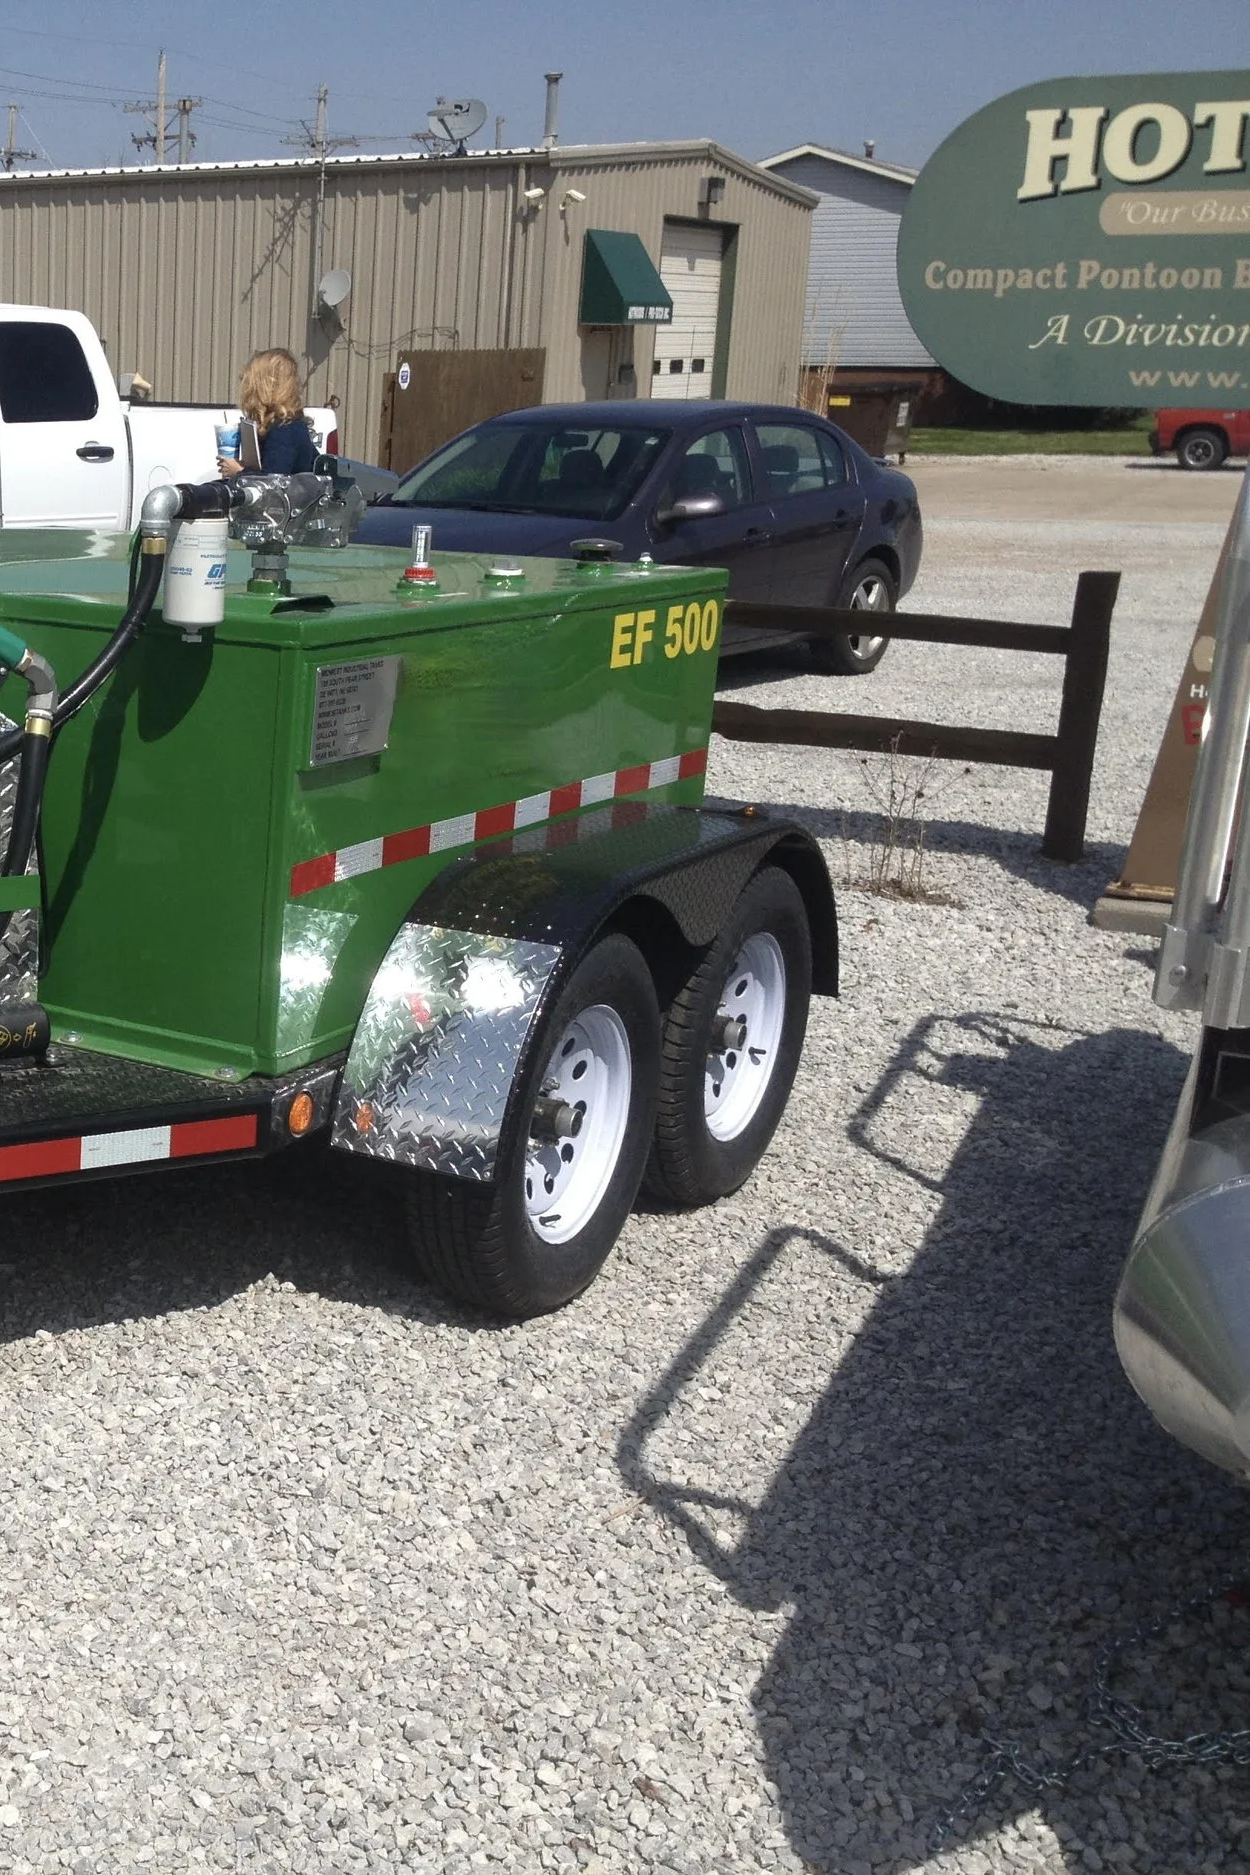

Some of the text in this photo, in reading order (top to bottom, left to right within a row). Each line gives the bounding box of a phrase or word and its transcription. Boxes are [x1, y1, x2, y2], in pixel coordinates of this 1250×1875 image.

[925, 260, 1067, 297] Compact
[1076, 259, 1223, 290] Pontoon
[1029, 314, 1070, 350] A
[610, 599, 718, 669] EF 500
